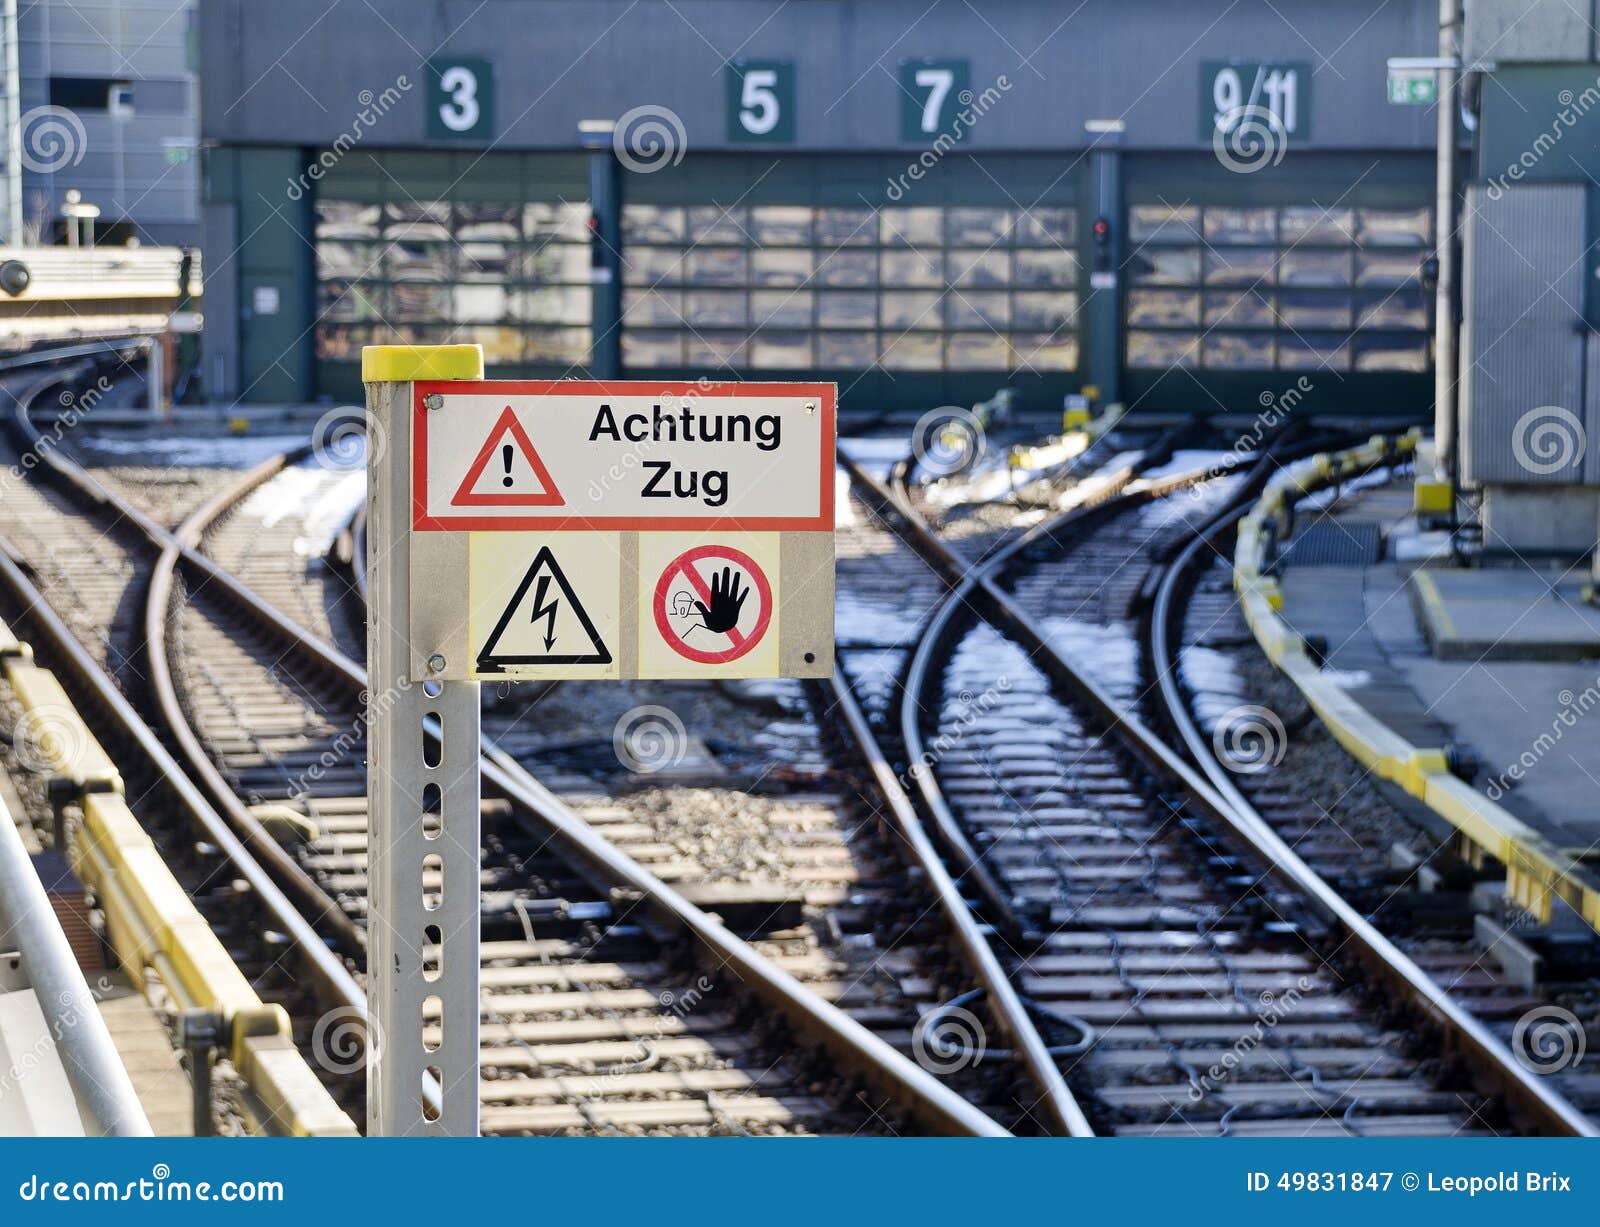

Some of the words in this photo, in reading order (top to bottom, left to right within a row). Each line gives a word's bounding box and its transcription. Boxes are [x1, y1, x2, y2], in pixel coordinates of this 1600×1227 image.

[440, 66, 480, 131] 3
[739, 69, 781, 134] 5
[915, 69, 954, 132] 7
[1213, 64, 1298, 135] 9/11
[588, 404, 781, 451] Achtung
[641, 461, 728, 507] Zug
